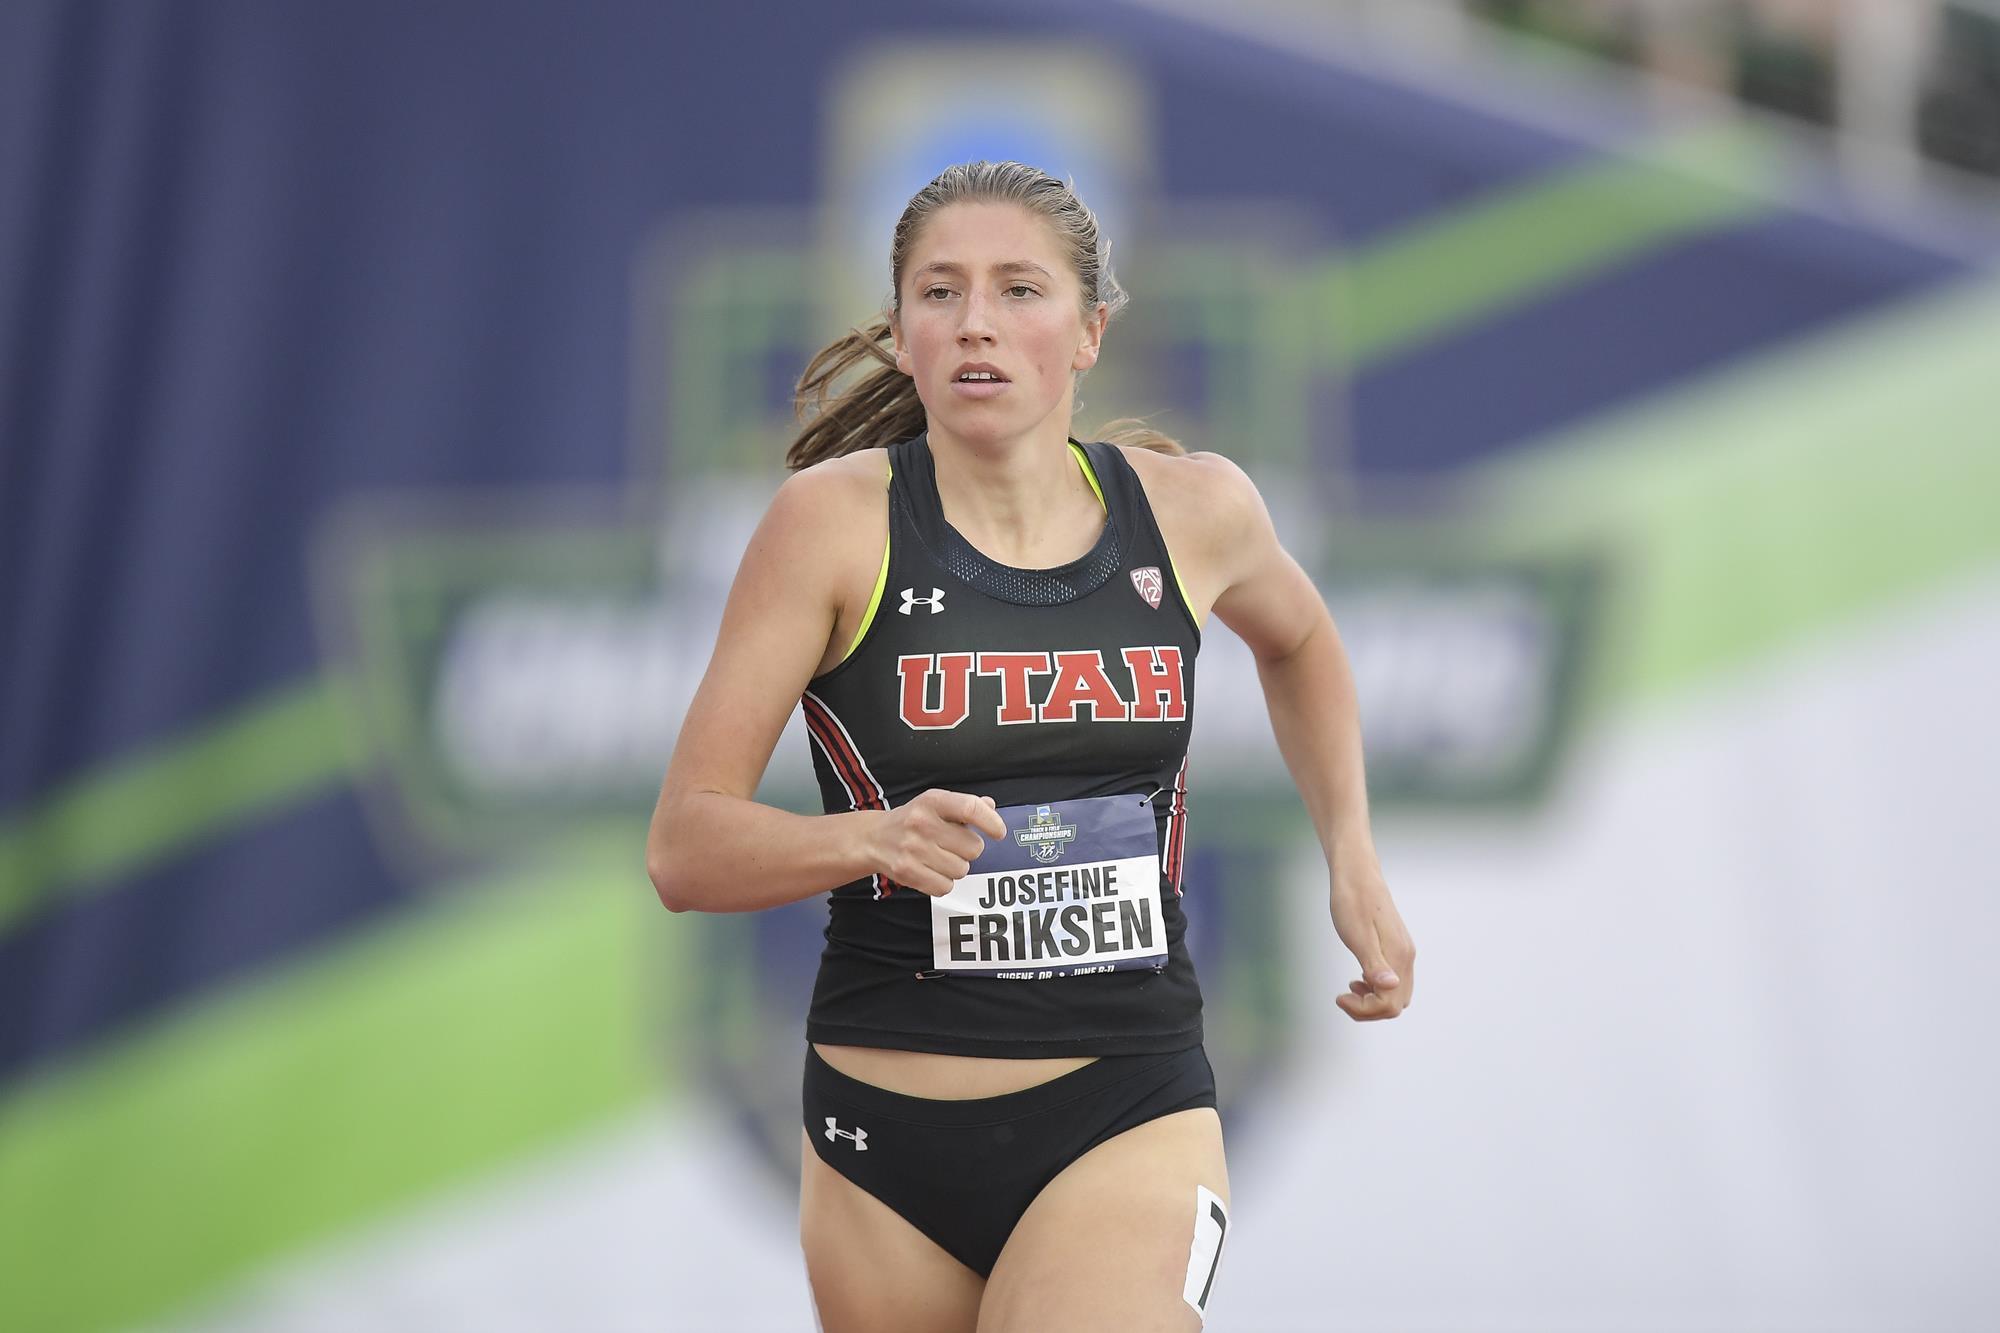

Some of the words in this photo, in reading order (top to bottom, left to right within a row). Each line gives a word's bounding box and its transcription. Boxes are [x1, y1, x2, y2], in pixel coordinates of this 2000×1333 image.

[1132, 569, 1161, 594] PAC
[1143, 586, 1161, 603] 12
[897, 646, 1187, 731] UTAH
[1020, 830, 1072, 841] CHAMPIONSHIPS
[979, 865, 1119, 909] JOSEFINE
[948, 898, 1154, 962] ERIKSEN
